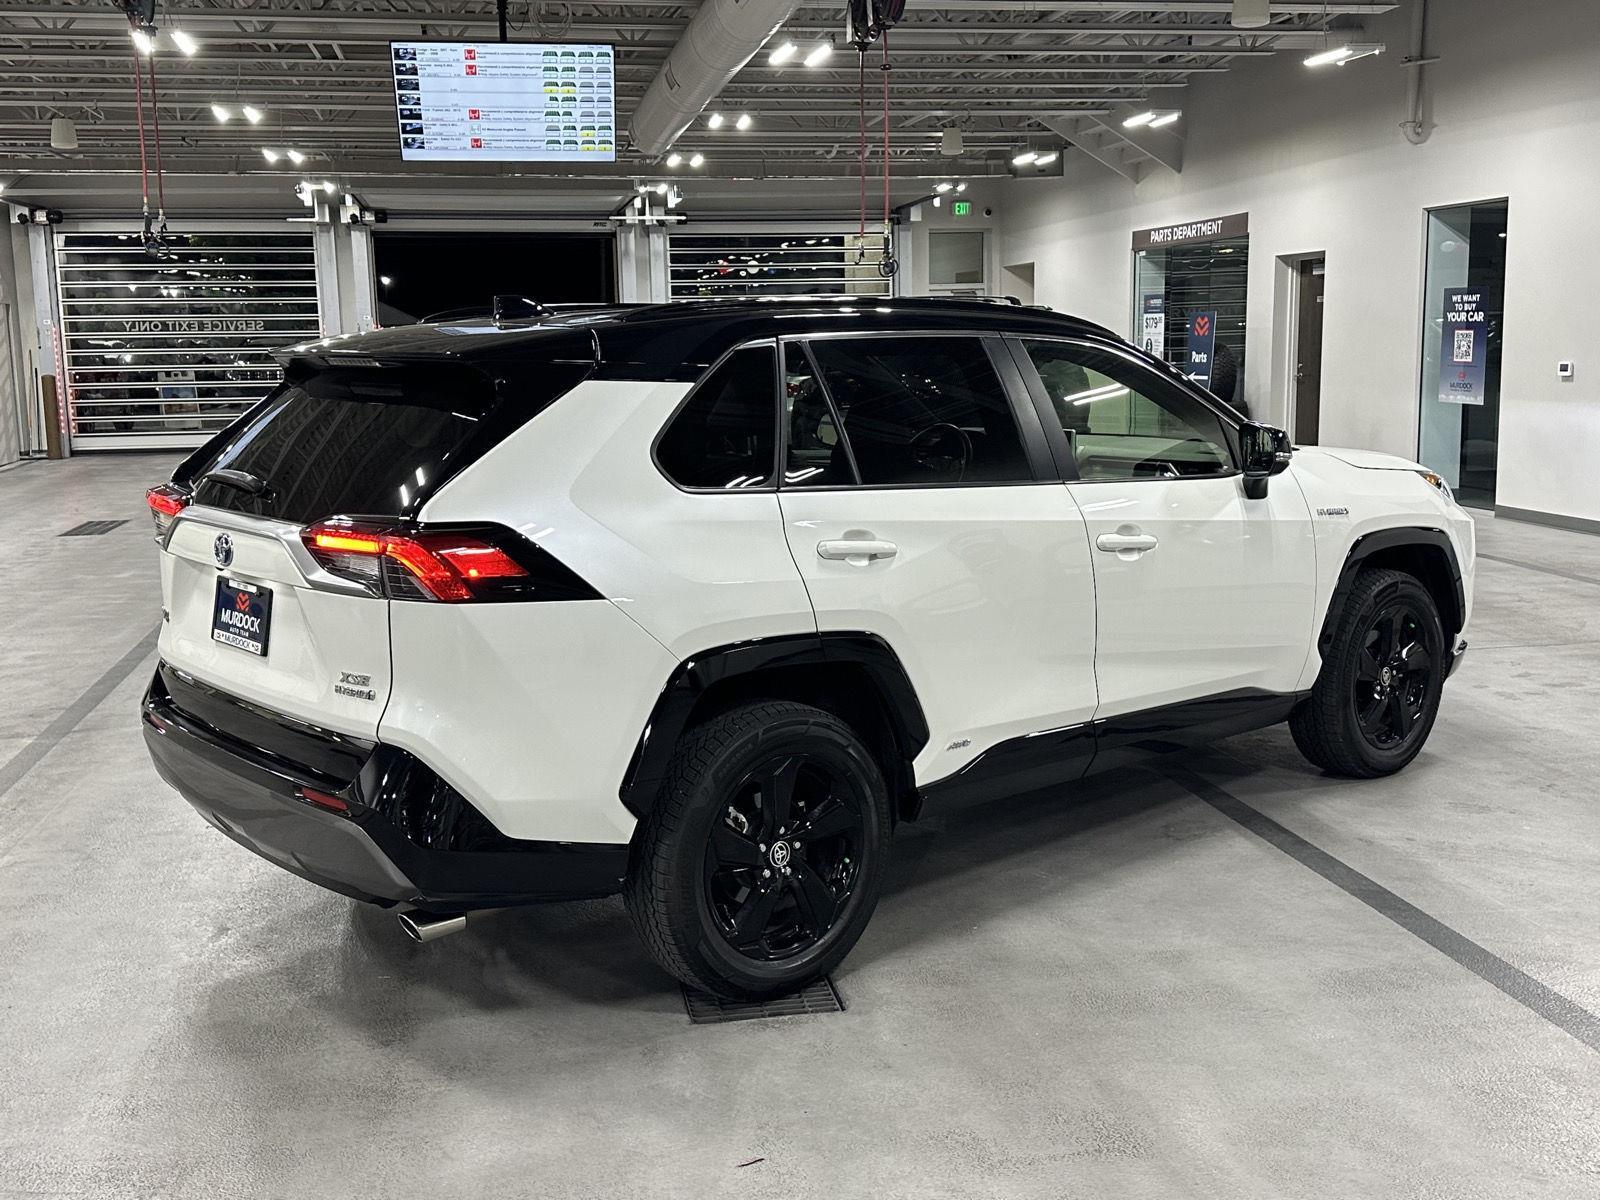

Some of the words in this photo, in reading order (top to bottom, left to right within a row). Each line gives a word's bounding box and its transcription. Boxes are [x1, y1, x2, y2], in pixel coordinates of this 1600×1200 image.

[955, 202, 970, 215] EXIT
[1150, 228, 1172, 243] PARTS
[1173, 220, 1223, 240] DEPARTMENT
[1451, 294, 1461, 302] WE
[1462, 294, 1480, 302] WANT
[1446, 312, 1467, 321] YOUR
[1467, 312, 1484, 321] CAR
[1191, 350, 1208, 363] Parts
[220, 607, 261, 634] MURDOCK
[229, 626, 240, 634] AUTO
[239, 629, 250, 637] TEAM
[339, 671, 371, 687] XSE
